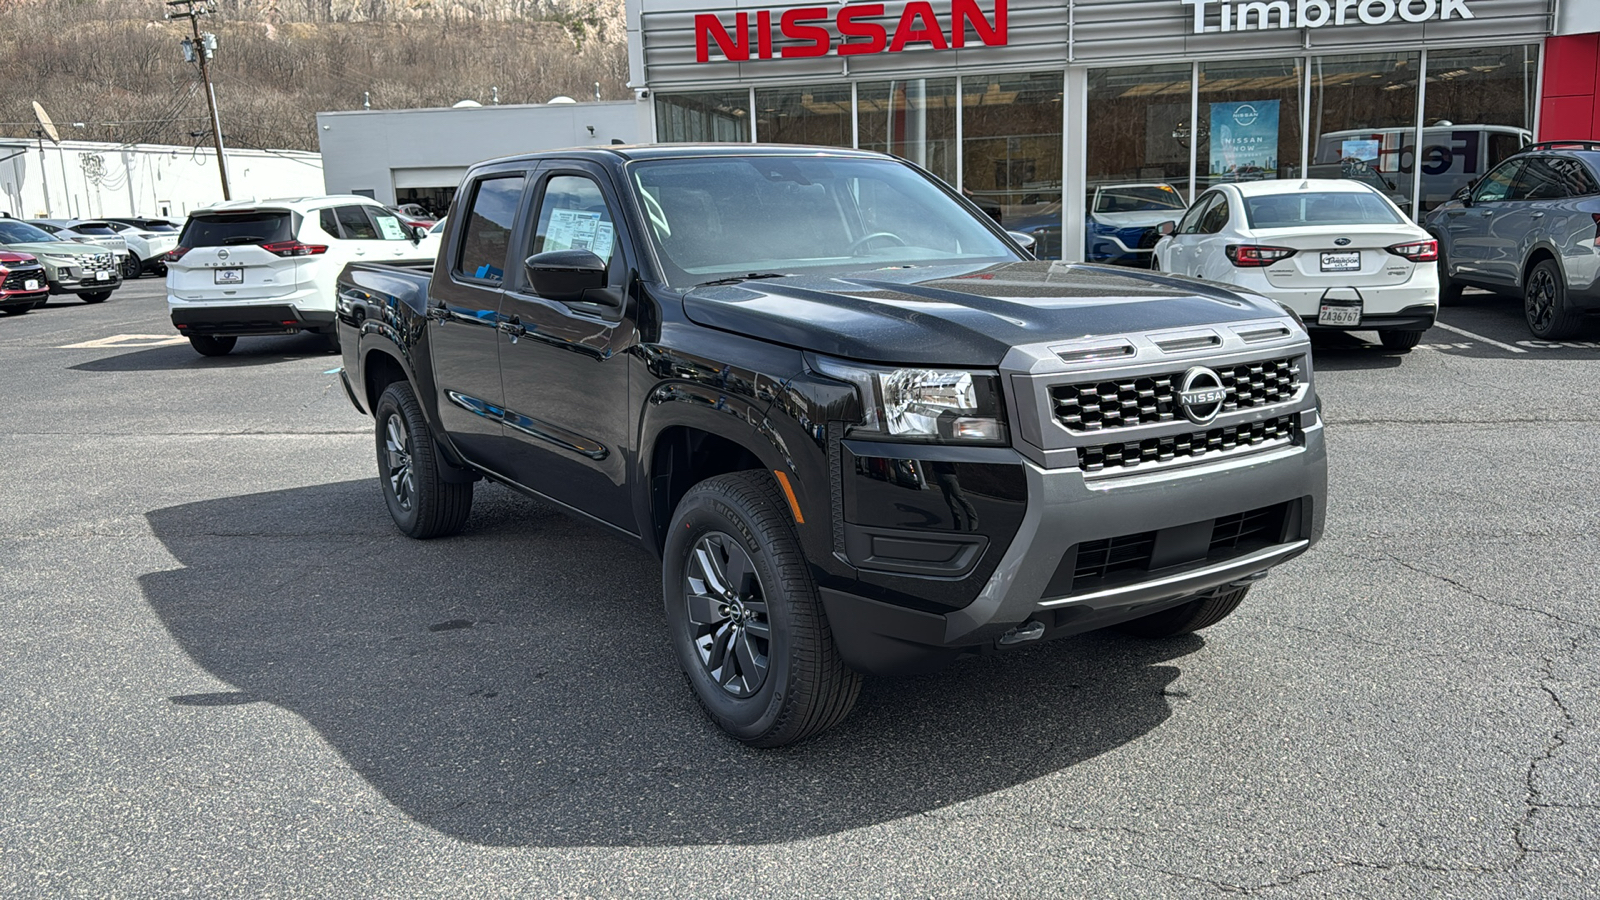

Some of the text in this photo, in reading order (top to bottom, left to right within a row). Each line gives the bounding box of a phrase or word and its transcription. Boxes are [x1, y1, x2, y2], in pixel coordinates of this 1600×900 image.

[694, 0, 1008, 63] NISSAN
[1181, 0, 1475, 34] Timbrook
[1182, 391, 1226, 404] NISSAN
[715, 501, 759, 551] MICHELIN
